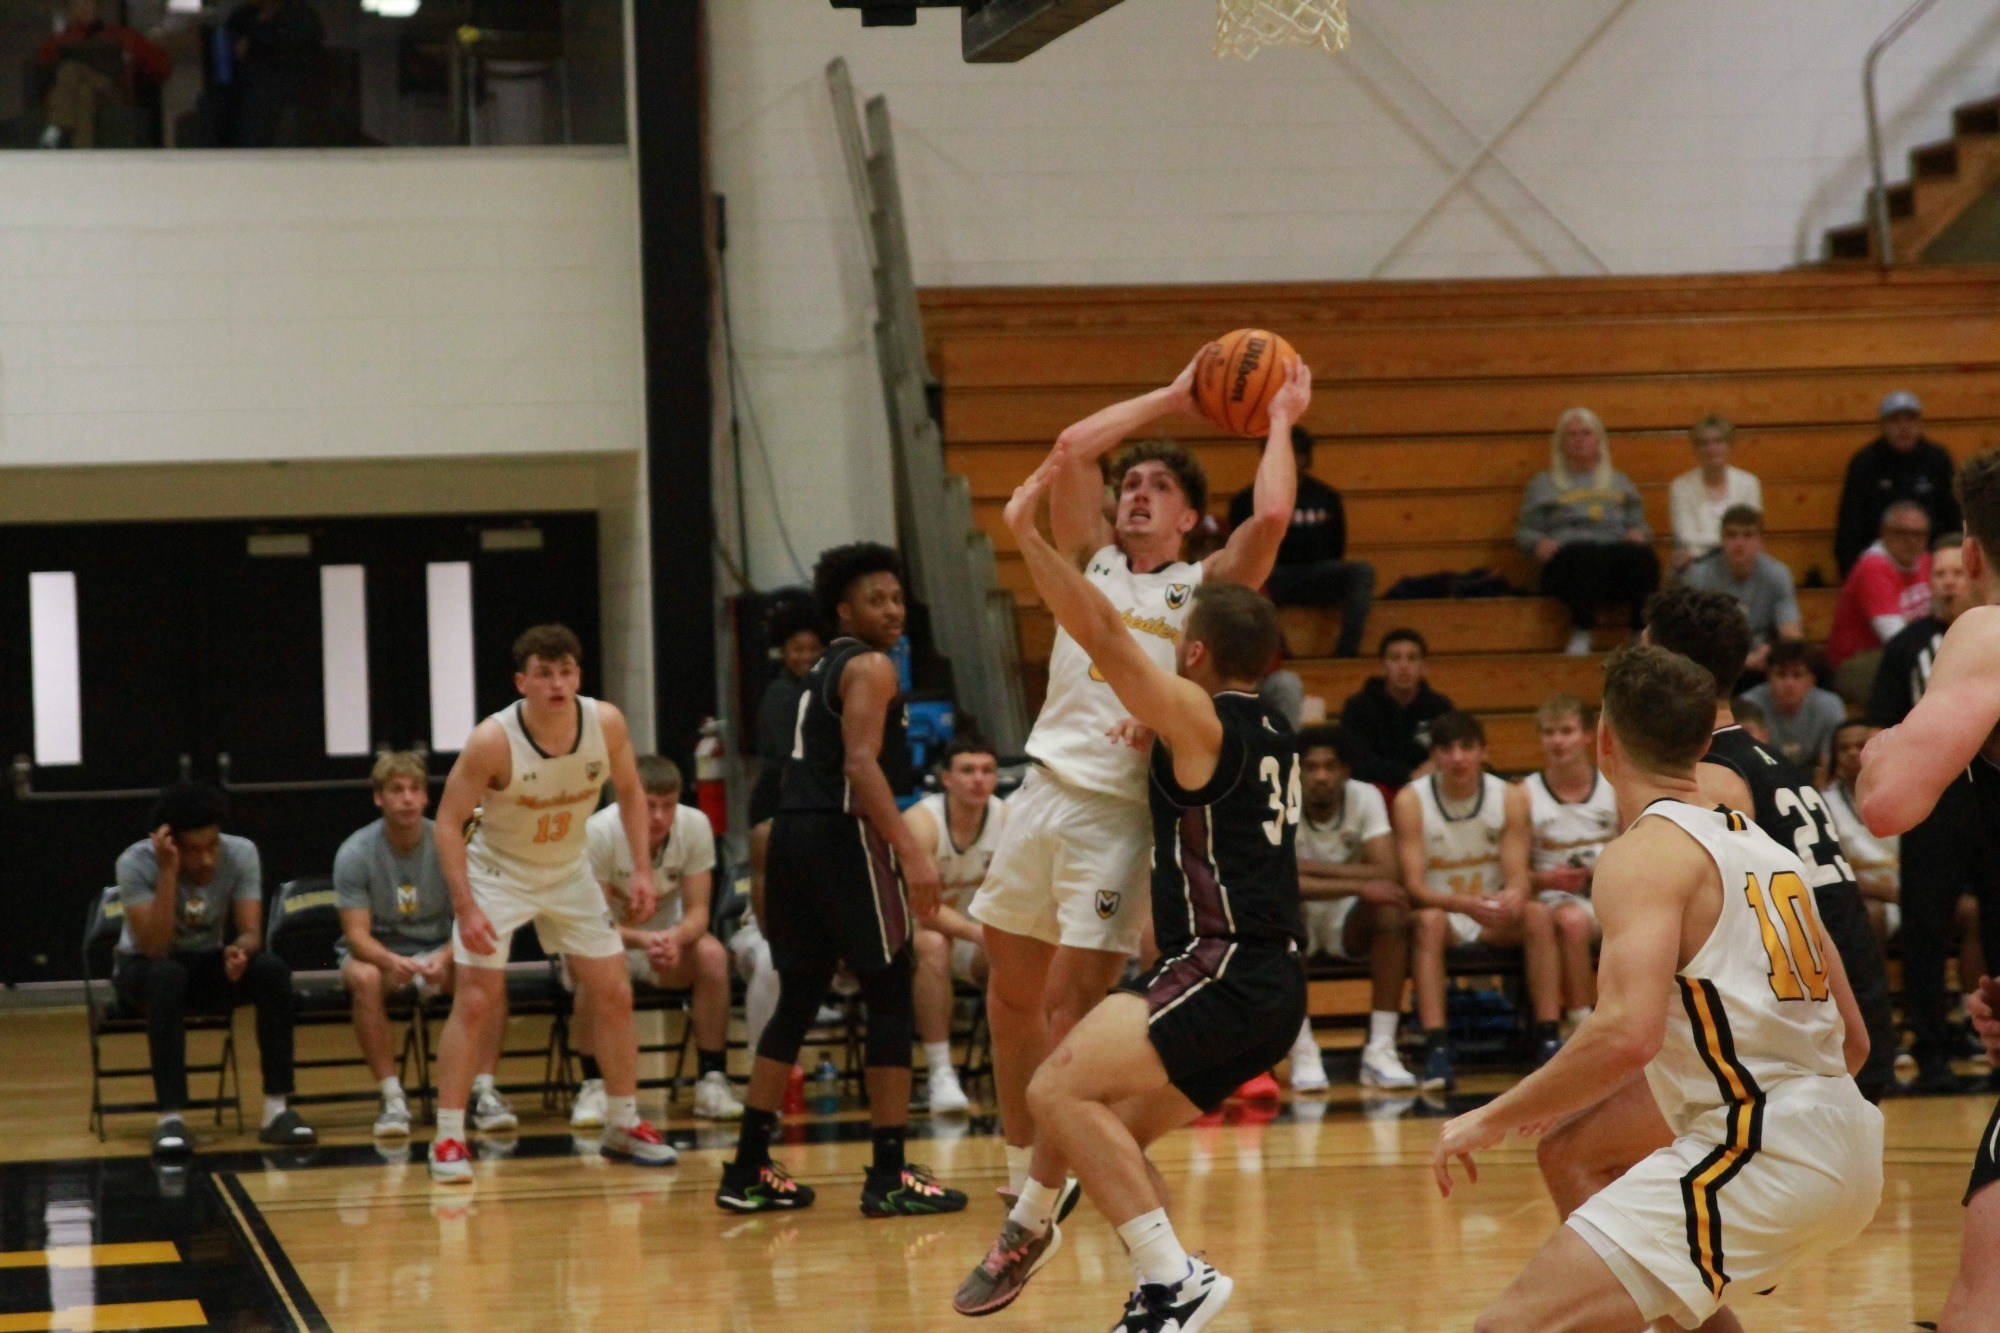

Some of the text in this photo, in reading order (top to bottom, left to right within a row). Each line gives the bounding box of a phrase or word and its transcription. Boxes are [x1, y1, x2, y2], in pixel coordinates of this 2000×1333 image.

[532, 811, 573, 845] 13
[1260, 752, 1302, 846] 34
[1744, 870, 1829, 1002] 10
